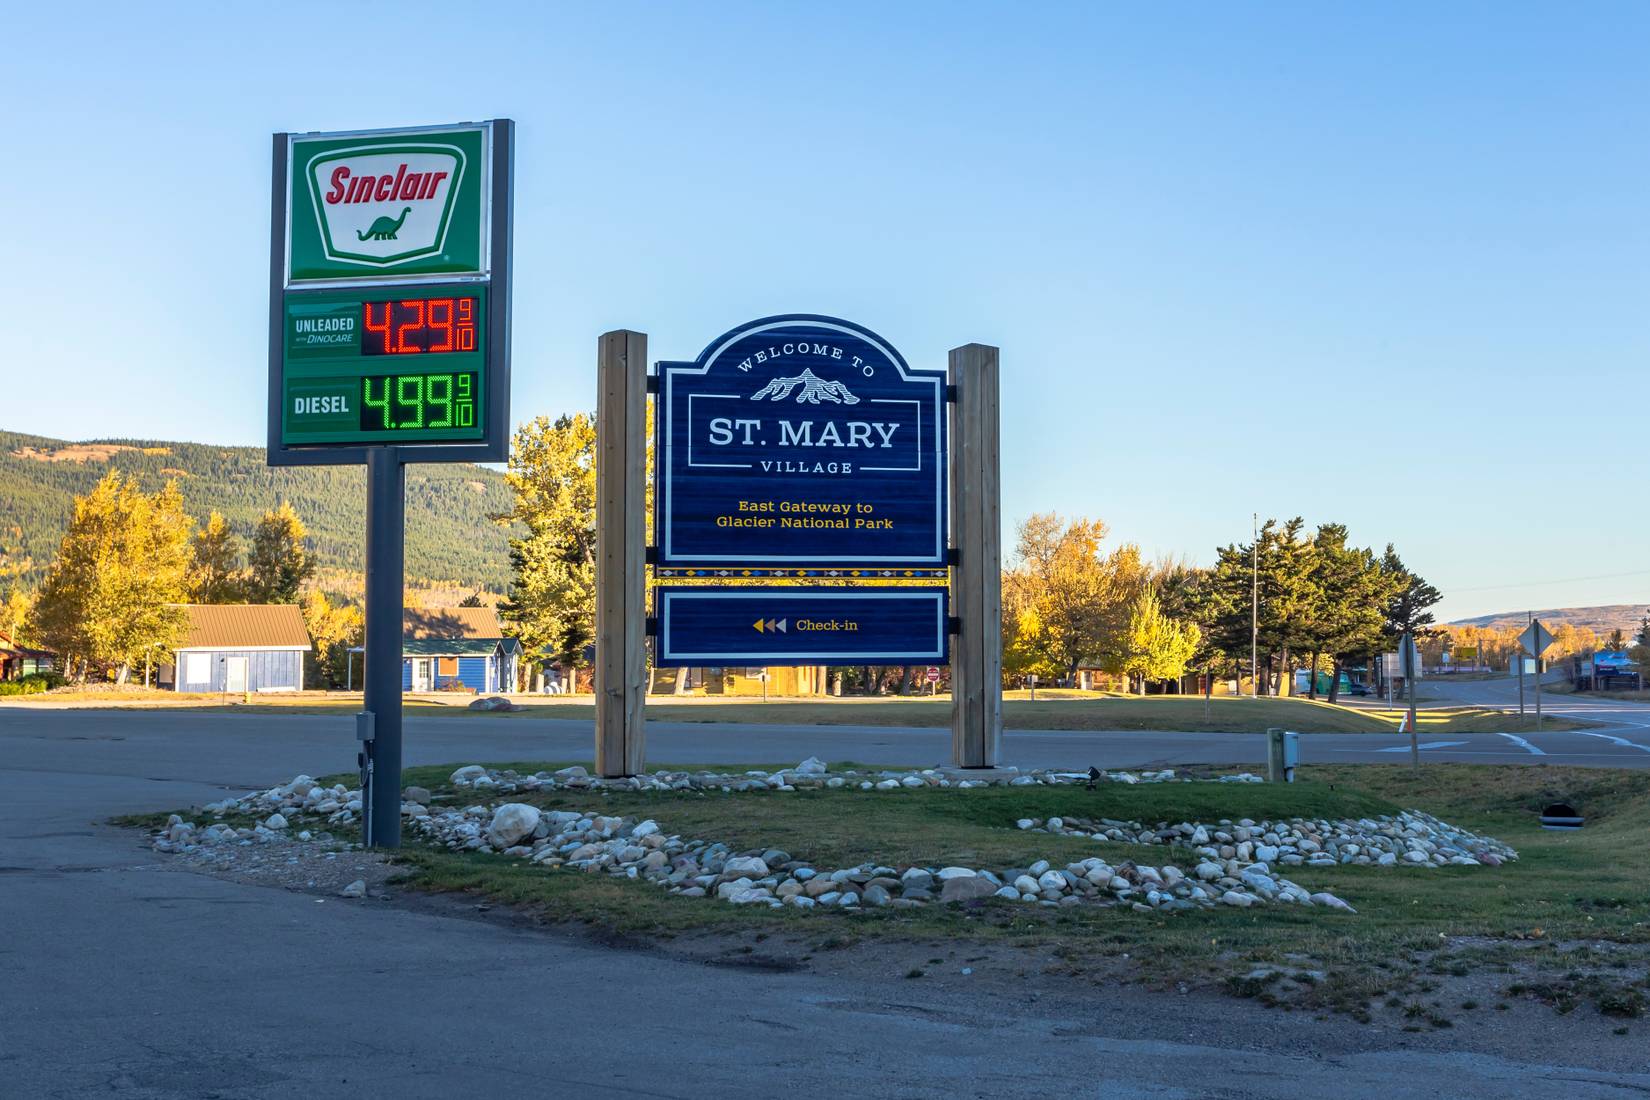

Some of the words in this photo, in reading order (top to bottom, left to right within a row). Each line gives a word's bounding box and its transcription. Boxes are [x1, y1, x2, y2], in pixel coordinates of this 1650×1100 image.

[326, 163, 448, 204] Sinclair
[296, 317, 354, 333] UNLEADED
[366, 299, 453, 353] 4.29
[307, 333, 353, 344] DINOCARE
[737, 342, 843, 373] WELCOME
[852, 355, 875, 377] TO
[295, 396, 349, 414] DIESEL
[365, 375, 452, 429] 4.99
[709, 418, 767, 446] ST.
[778, 420, 900, 448] MARY
[760, 461, 853, 474] VILLAGE
[738, 500, 775, 512] East
[780, 501, 851, 515] Gateway
[856, 502, 873, 513] to
[716, 515, 776, 528] Glacier
[780, 516, 850, 529] National
[854, 518, 894, 529] Park
[796, 618, 858, 631] Check-in
